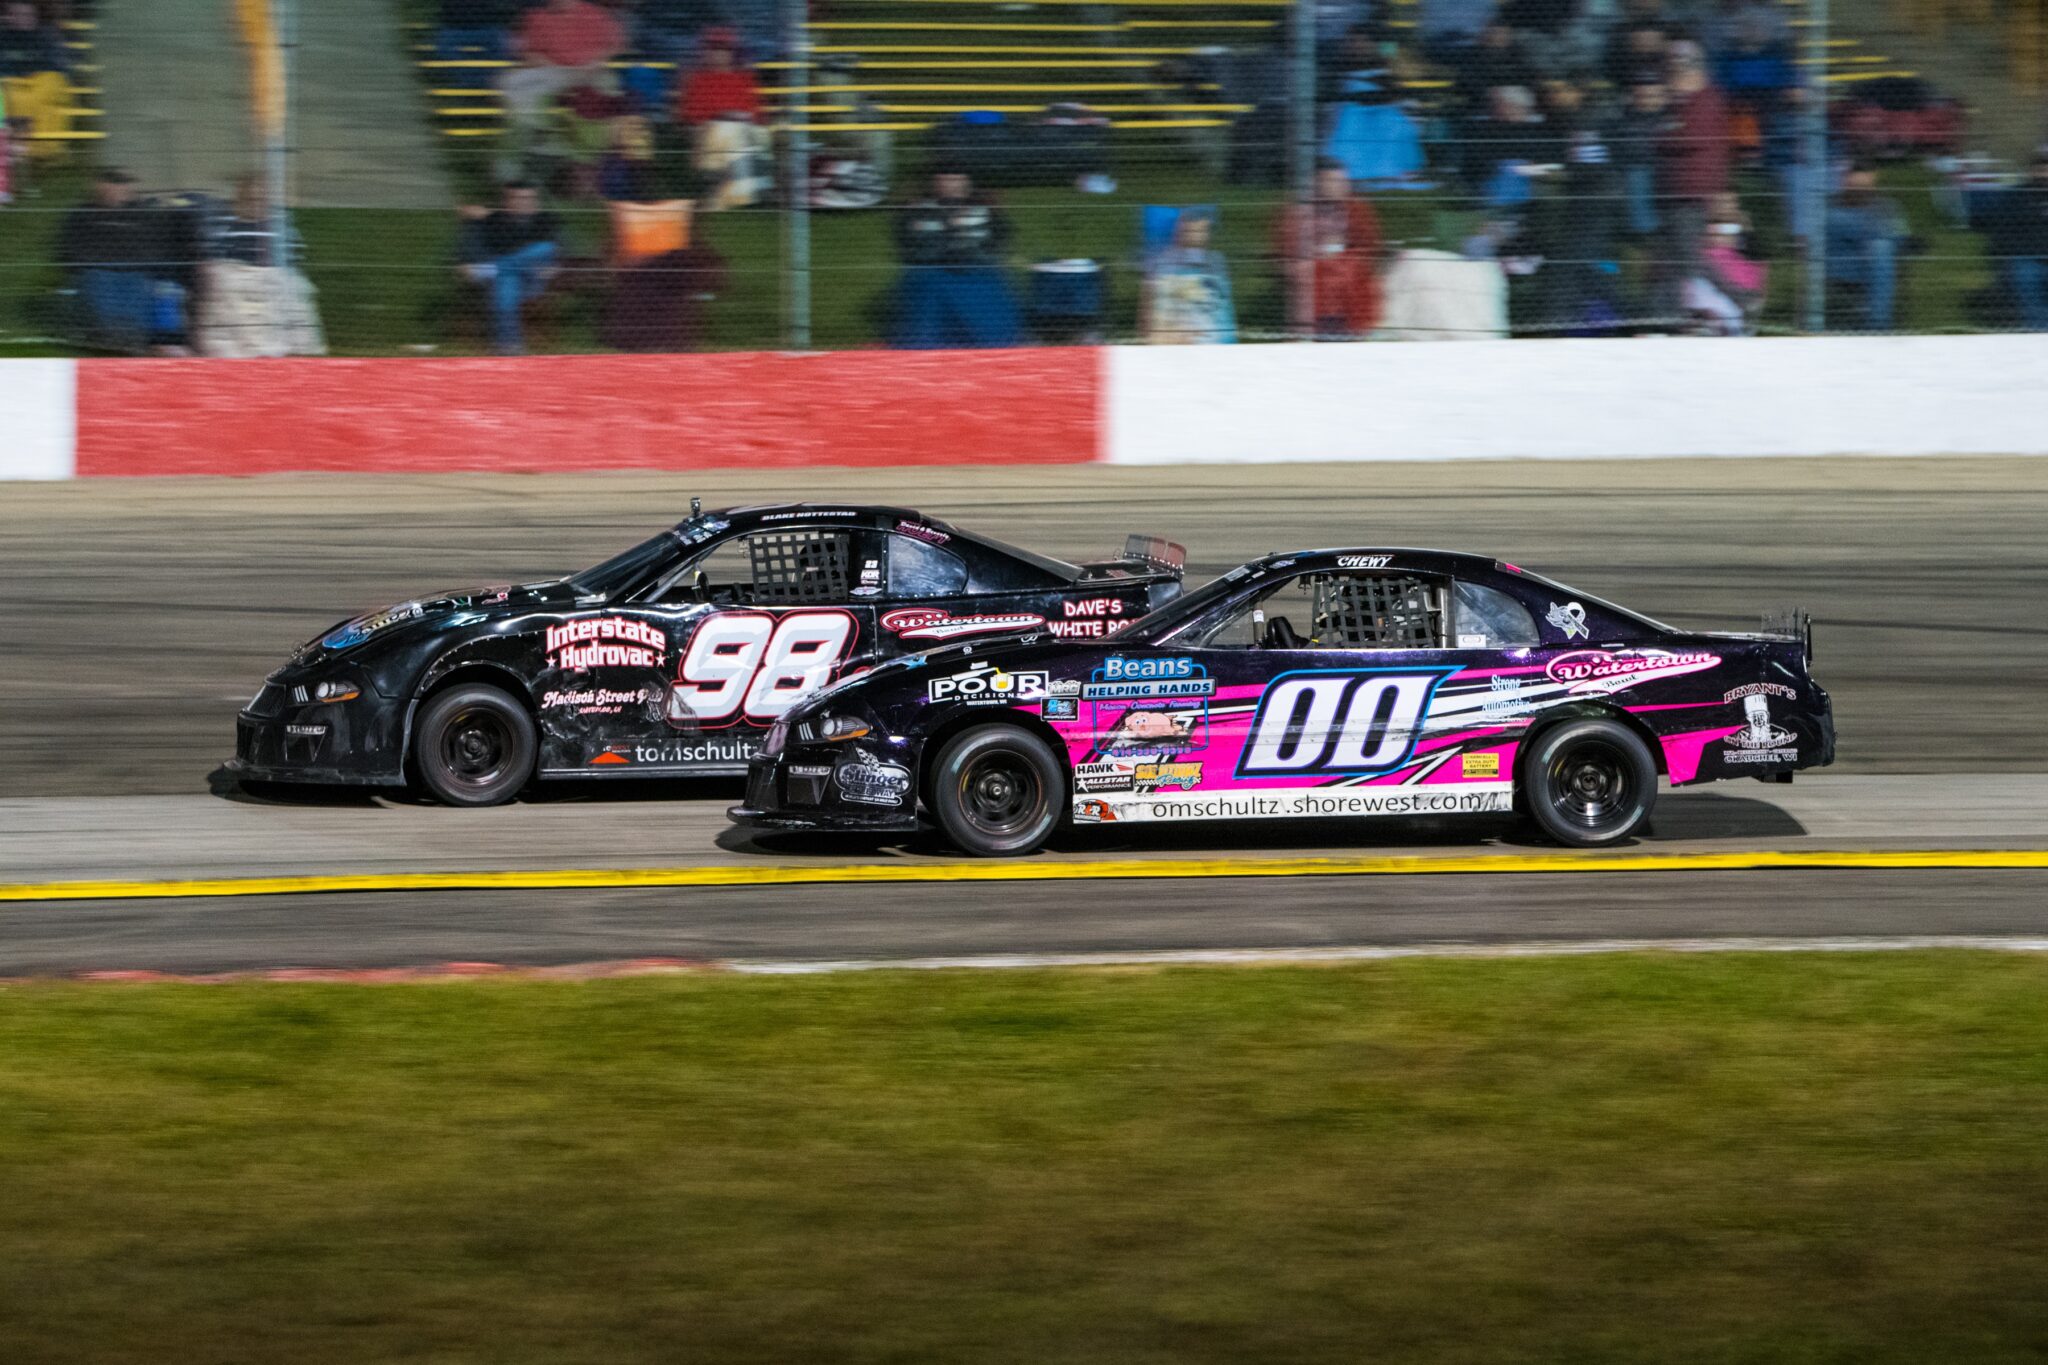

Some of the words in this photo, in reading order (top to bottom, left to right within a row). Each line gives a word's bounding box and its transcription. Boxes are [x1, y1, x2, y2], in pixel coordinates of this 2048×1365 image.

[1337, 556, 1393, 568] CHEWY
[1063, 599, 1122, 617] DAVE'S
[884, 608, 1038, 630] Watertown
[1048, 620, 1102, 638] WHITE
[546, 616, 666, 654] Interstate
[560, 640, 655, 673] Hydrovac
[667, 611, 853, 720] 98
[1547, 651, 1714, 682] Watertown
[1105, 658, 1191, 679] Beans
[934, 674, 1042, 698] POUR
[954, 692, 1023, 701] DECISIONS
[1087, 684, 1150, 697] HELPING
[1158, 682, 1210, 694] HANDS
[1723, 682, 1797, 704] BRYANT'S
[541, 689, 594, 709] Madison
[595, 688, 636, 705] Street
[1243, 674, 1438, 770] 00
[841, 765, 908, 787] Slinger
[1077, 763, 1115, 774] HAWK
[1087, 776, 1131, 784] ALLSTAR
